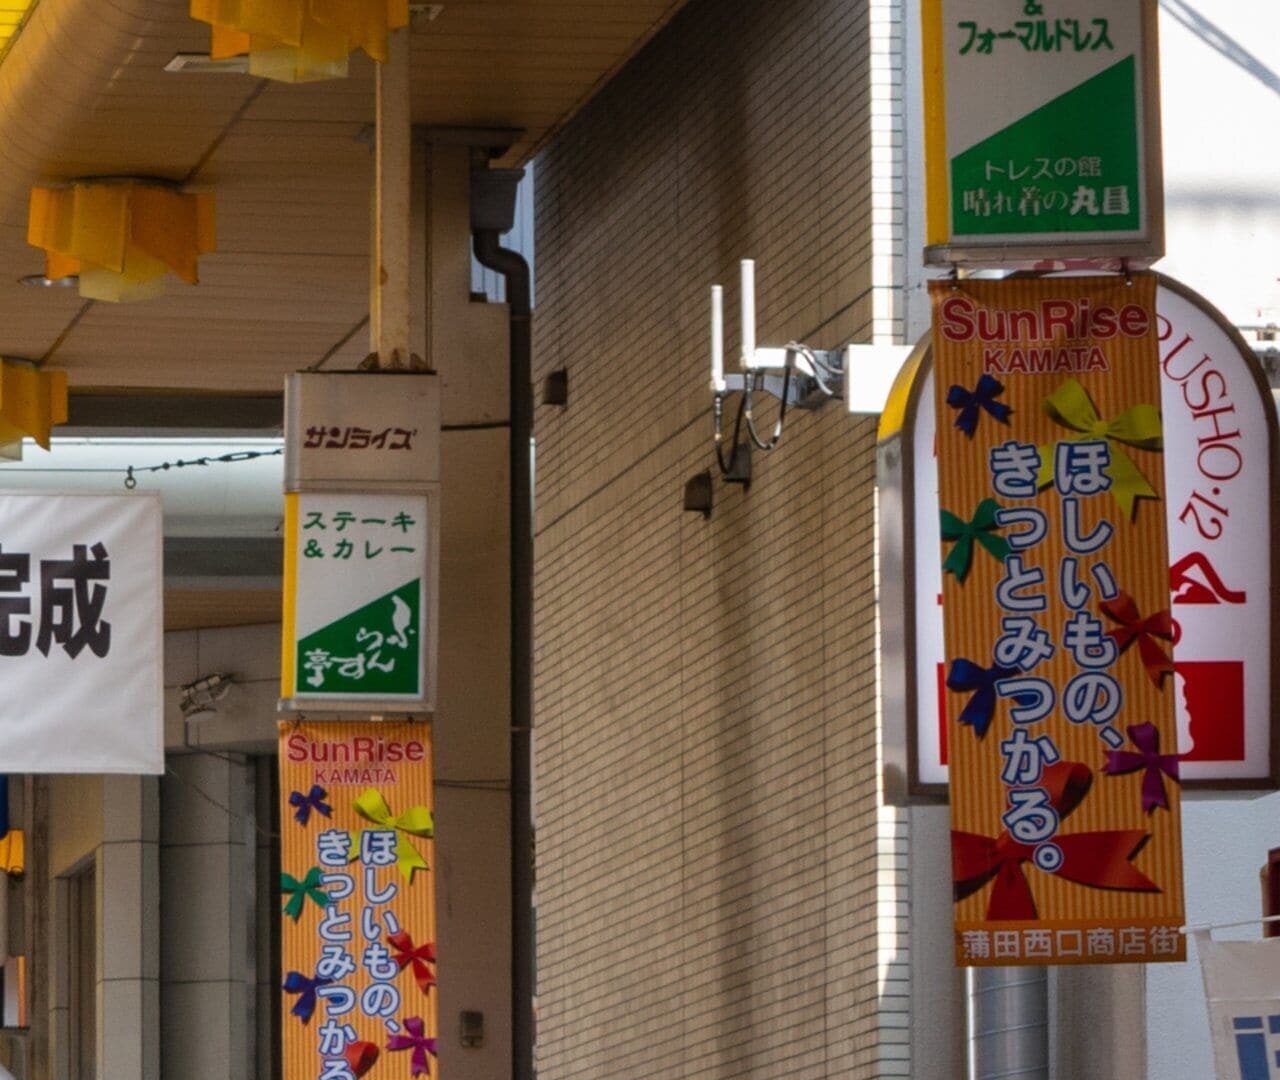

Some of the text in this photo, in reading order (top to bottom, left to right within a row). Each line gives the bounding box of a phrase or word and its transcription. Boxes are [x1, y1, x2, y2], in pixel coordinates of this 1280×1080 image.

[957, 18, 1115, 56] フォーマルドレス
[941, 299, 1151, 343] SunRise
[983, 344, 1112, 375] KAMATA
[303, 425, 417, 451] サンライズ
[302, 511, 417, 532] ステーキ
[302, 538, 417, 560] &カレー
[1053, 439, 1124, 750] ほしいもの、
[989, 438, 1066, 873] きっとみつかる。
[286, 734, 425, 764] SunRise
[314, 767, 398, 785] KAMATA
[360, 829, 400, 1035] ほしいもの、
[961, 926, 1181, 961] 蒲田西口商店街
